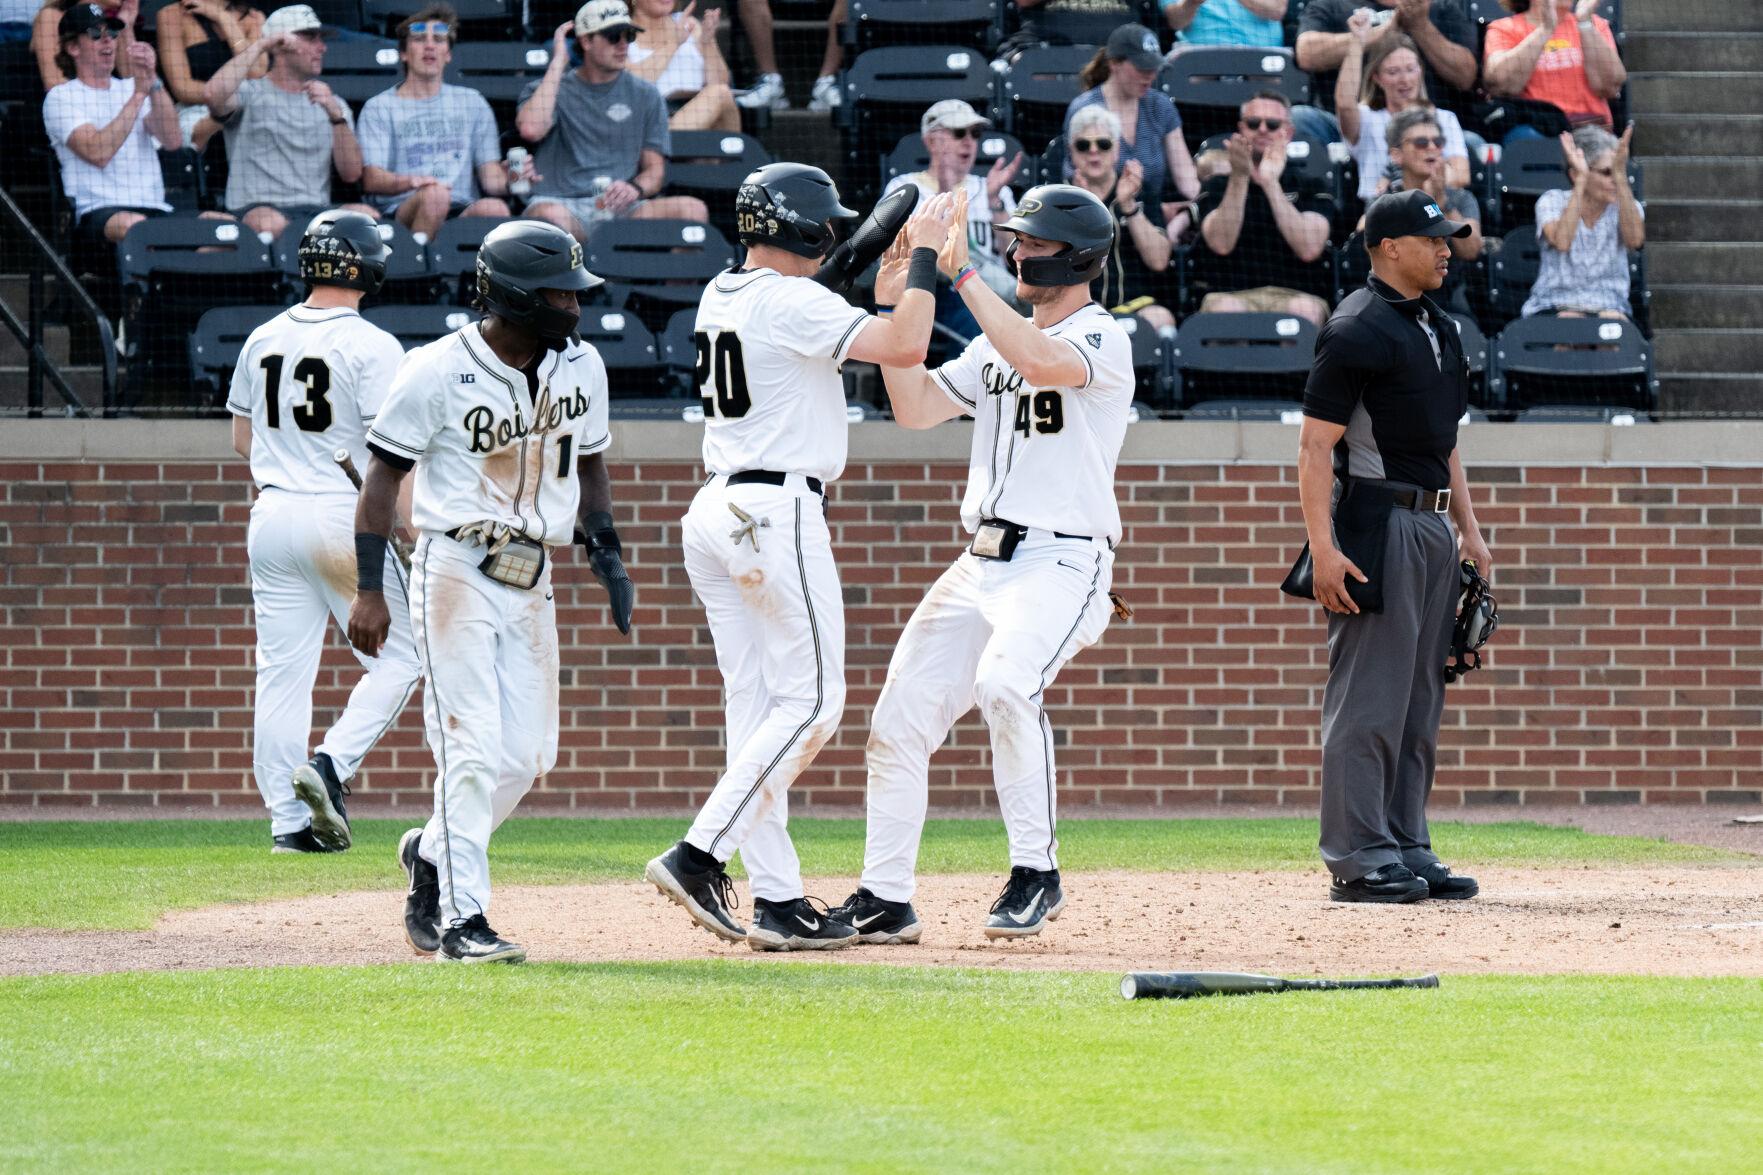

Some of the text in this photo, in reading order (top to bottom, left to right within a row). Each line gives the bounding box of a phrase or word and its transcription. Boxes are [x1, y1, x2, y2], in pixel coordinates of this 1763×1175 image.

[314, 261, 332, 278] 13
[259, 353, 334, 432] 13
[1014, 390, 1064, 439] 49
[463, 385, 591, 453] Boilers
[556, 434, 573, 479] 1
